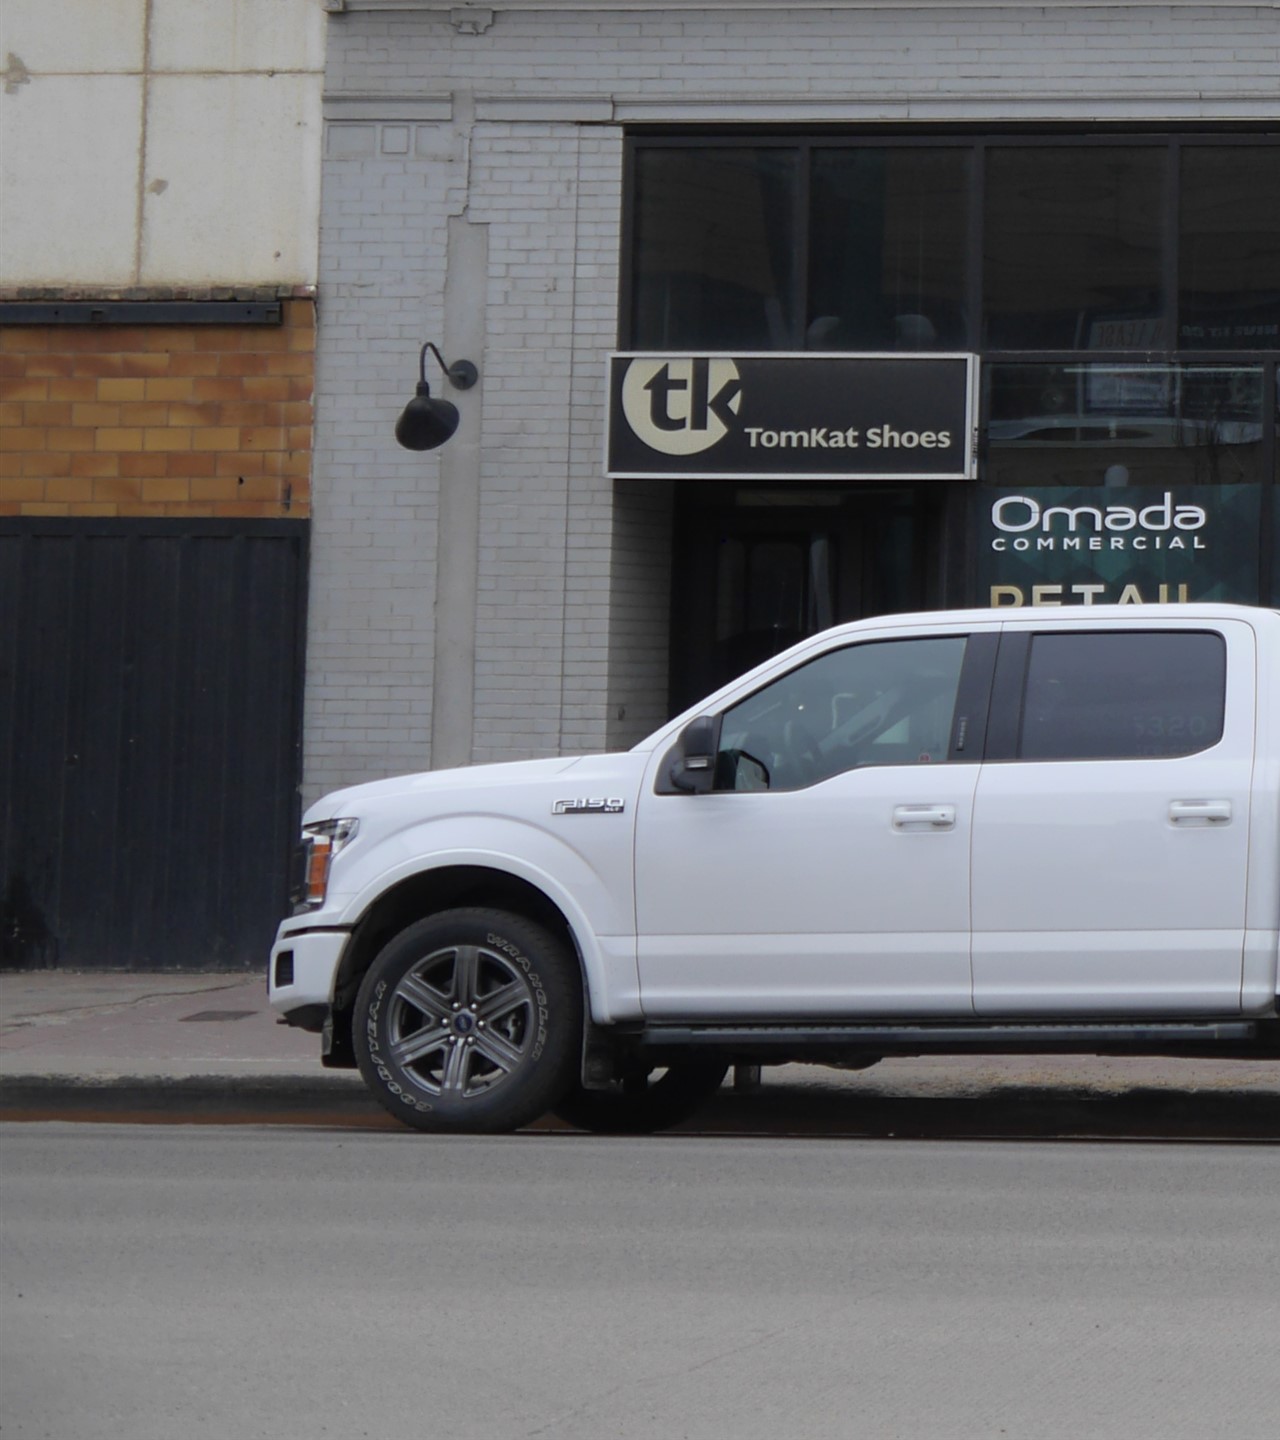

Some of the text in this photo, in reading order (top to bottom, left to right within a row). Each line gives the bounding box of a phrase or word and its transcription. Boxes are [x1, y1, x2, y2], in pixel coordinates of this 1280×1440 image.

[744, 427, 859, 450] TomKat
[866, 424, 952, 450] Shoes
[991, 492, 1207, 532] Omada
[991, 535, 1207, 552] COMMERCIAL
[486, 931, 552, 1063] WRANGLER
